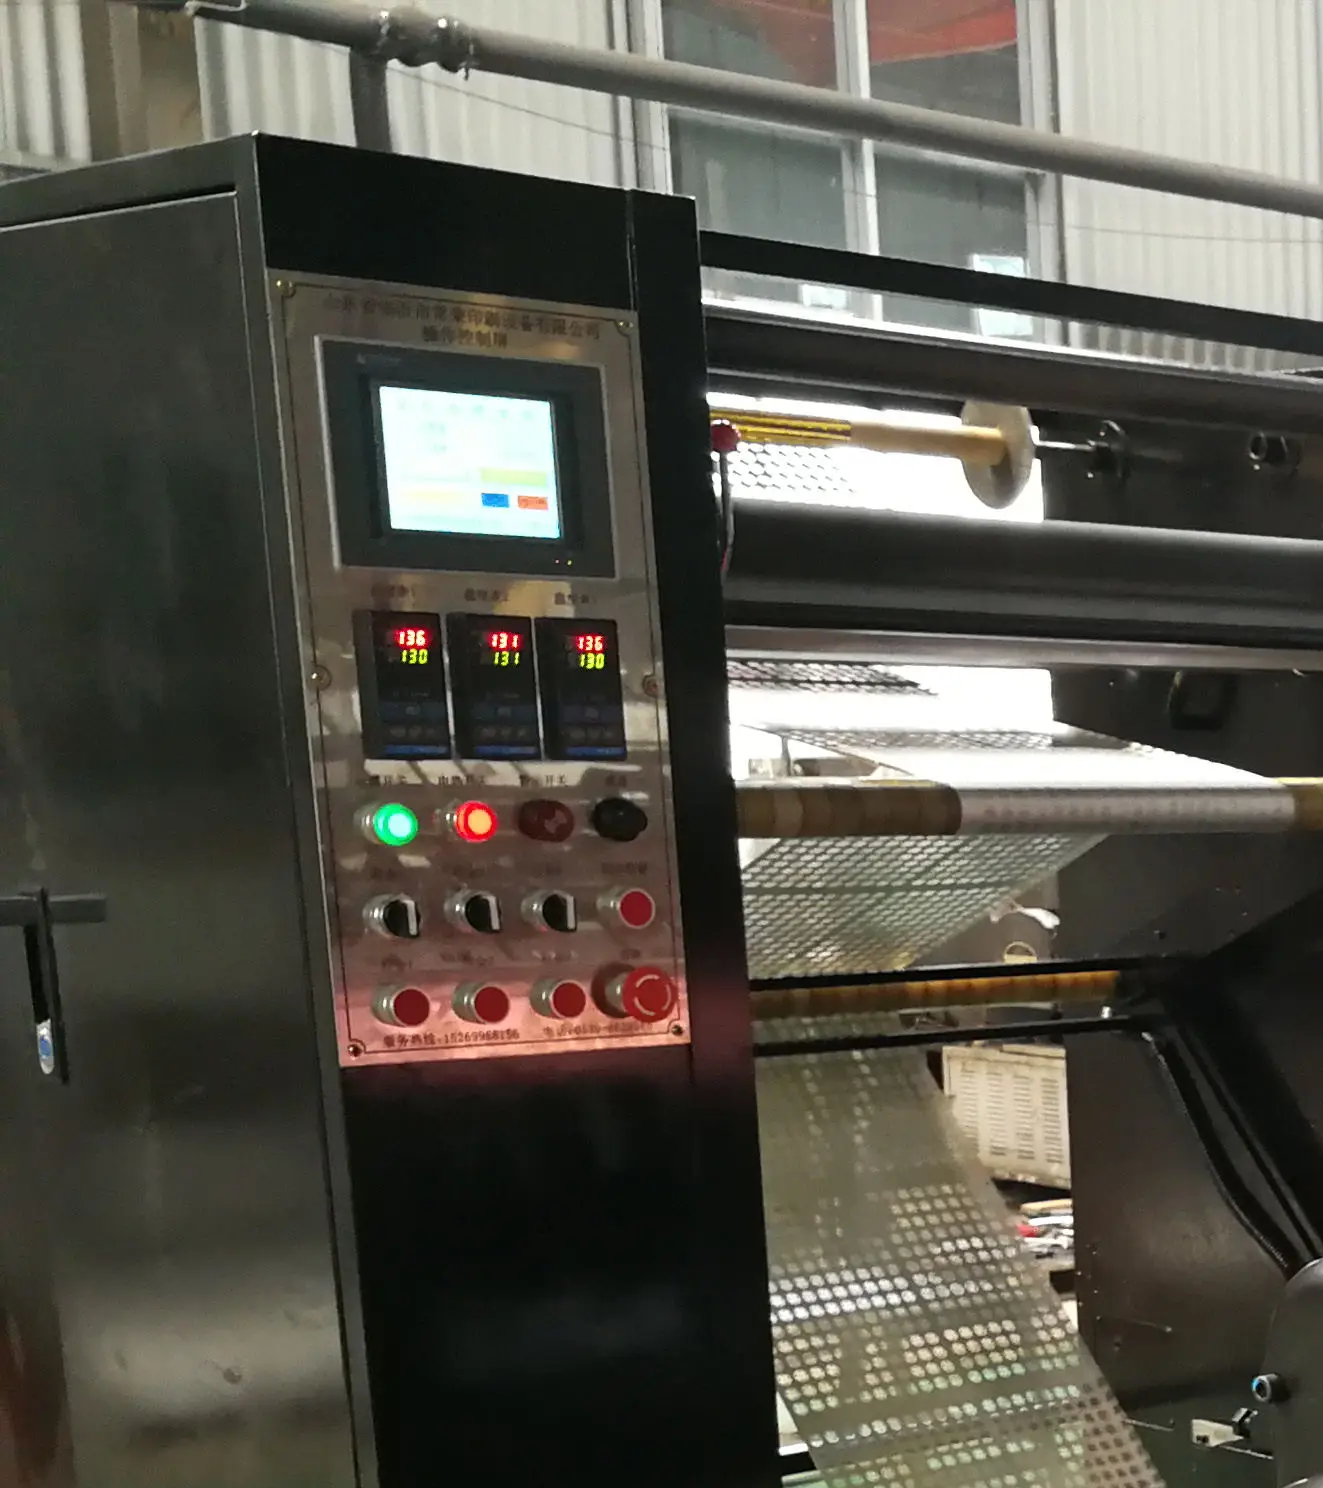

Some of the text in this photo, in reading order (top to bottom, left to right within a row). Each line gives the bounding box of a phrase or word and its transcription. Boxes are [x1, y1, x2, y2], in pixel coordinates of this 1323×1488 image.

[397, 630, 426, 647] 136
[491, 633, 519, 649] 131
[577, 635, 604, 651] 136
[401, 649, 428, 665] 130
[494, 651, 520, 667] 131
[579, 653, 605, 669] 130
